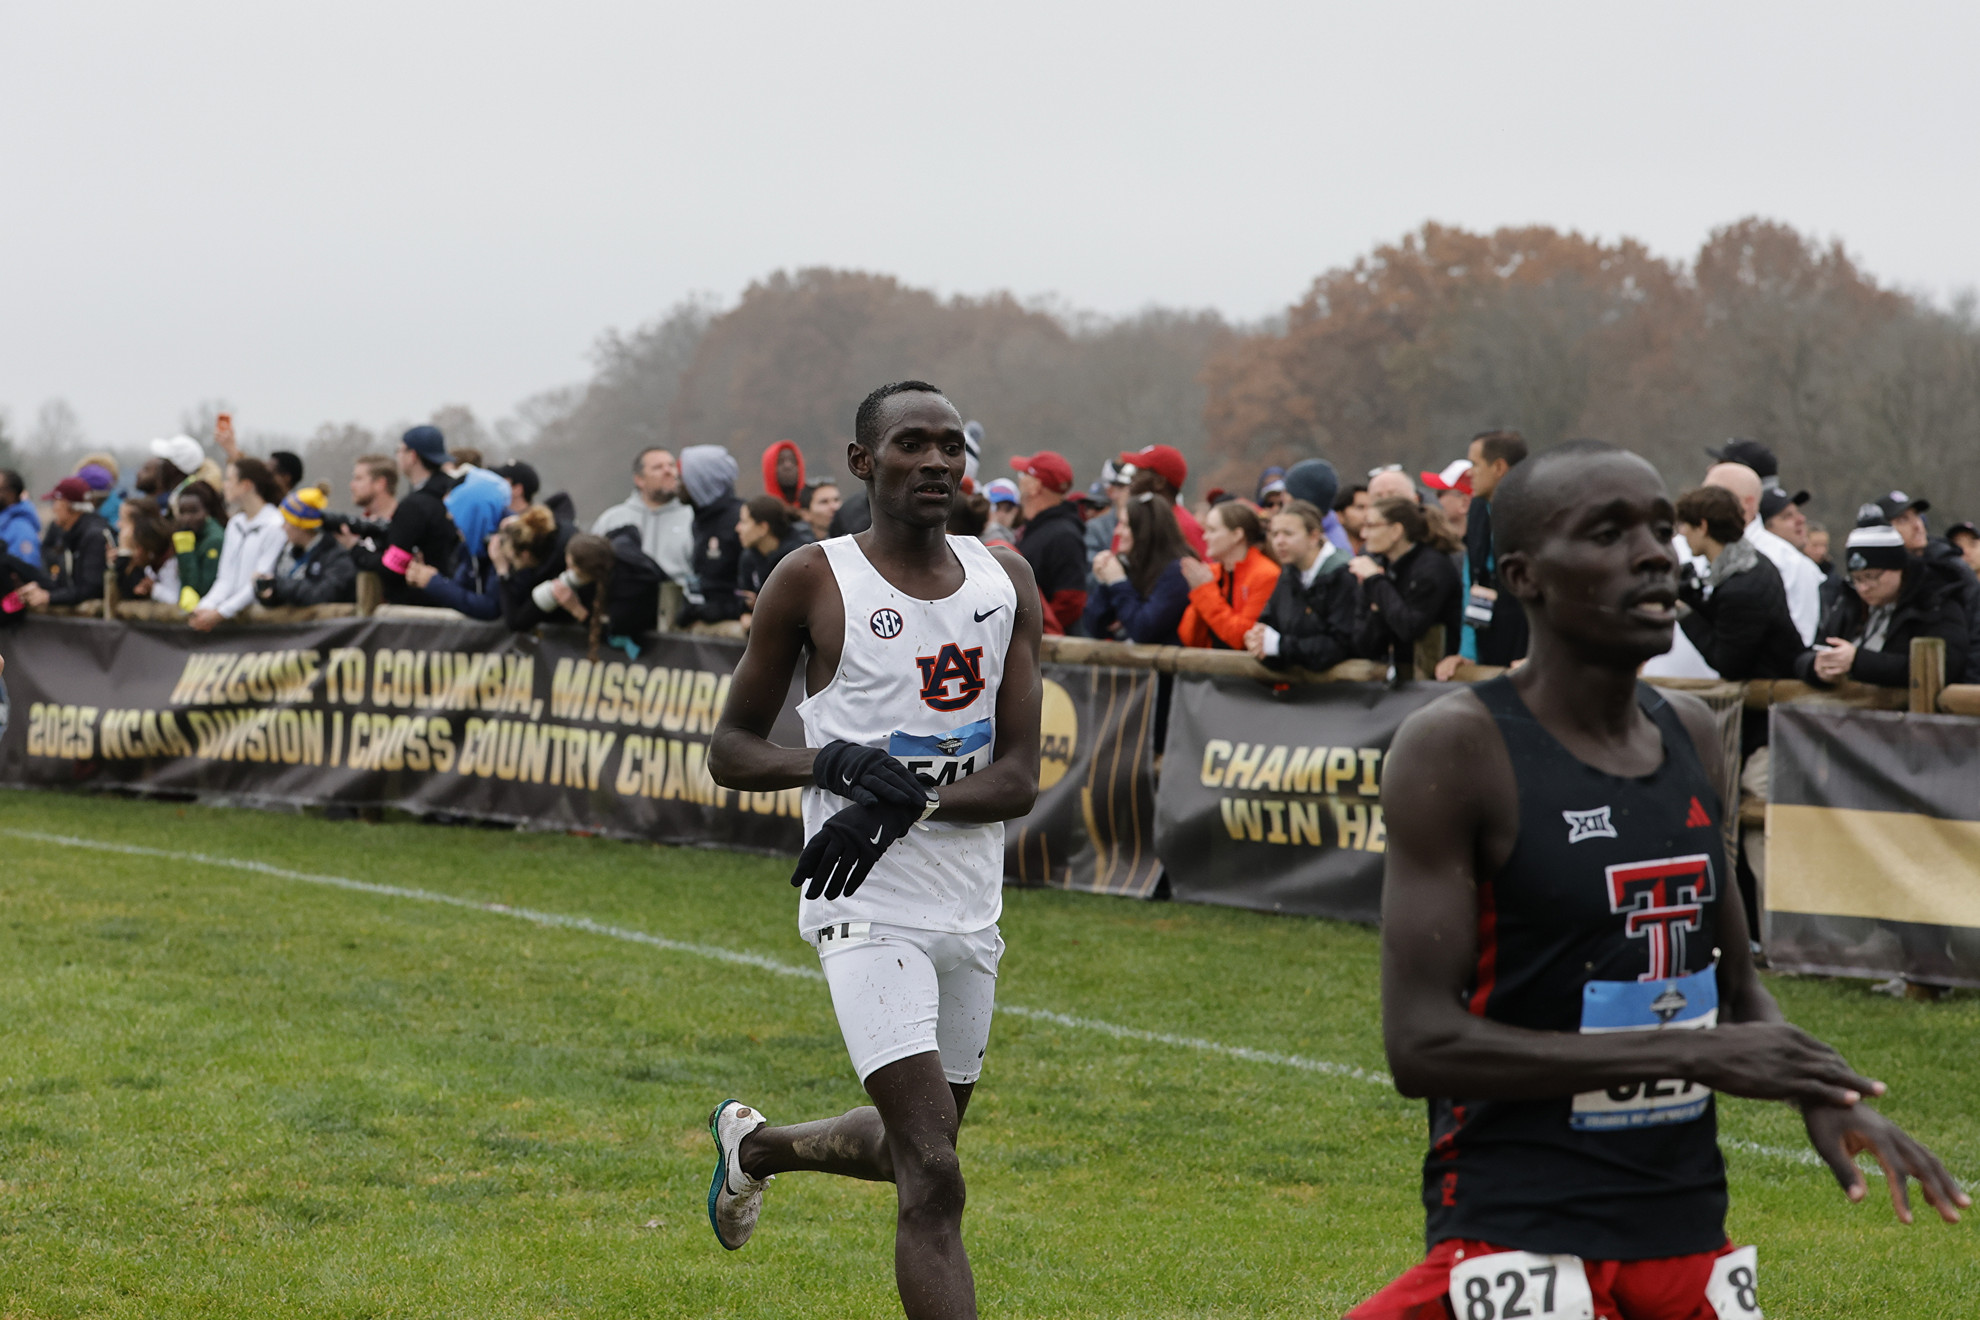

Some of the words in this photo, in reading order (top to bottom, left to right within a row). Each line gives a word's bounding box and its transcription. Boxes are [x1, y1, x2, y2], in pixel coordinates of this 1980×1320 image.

[871, 609, 902, 638] SEC
[171, 651, 320, 704] WELCOME
[327, 647, 366, 705] TO
[372, 648, 544, 721] COLUMBIA,
[27, 702, 98, 760] 2025
[101, 708, 192, 760] NCAA
[187, 708, 324, 767] DIVISION
[330, 710, 344, 768] I
[348, 711, 456, 773] CROSS
[458, 717, 616, 791] COUNTRY
[1200, 738, 1382, 797] CHAMPI
[1220, 797, 1322, 847] WIN
[1335, 803, 1389, 854] HE
[1465, 1265, 1557, 1320] 827
